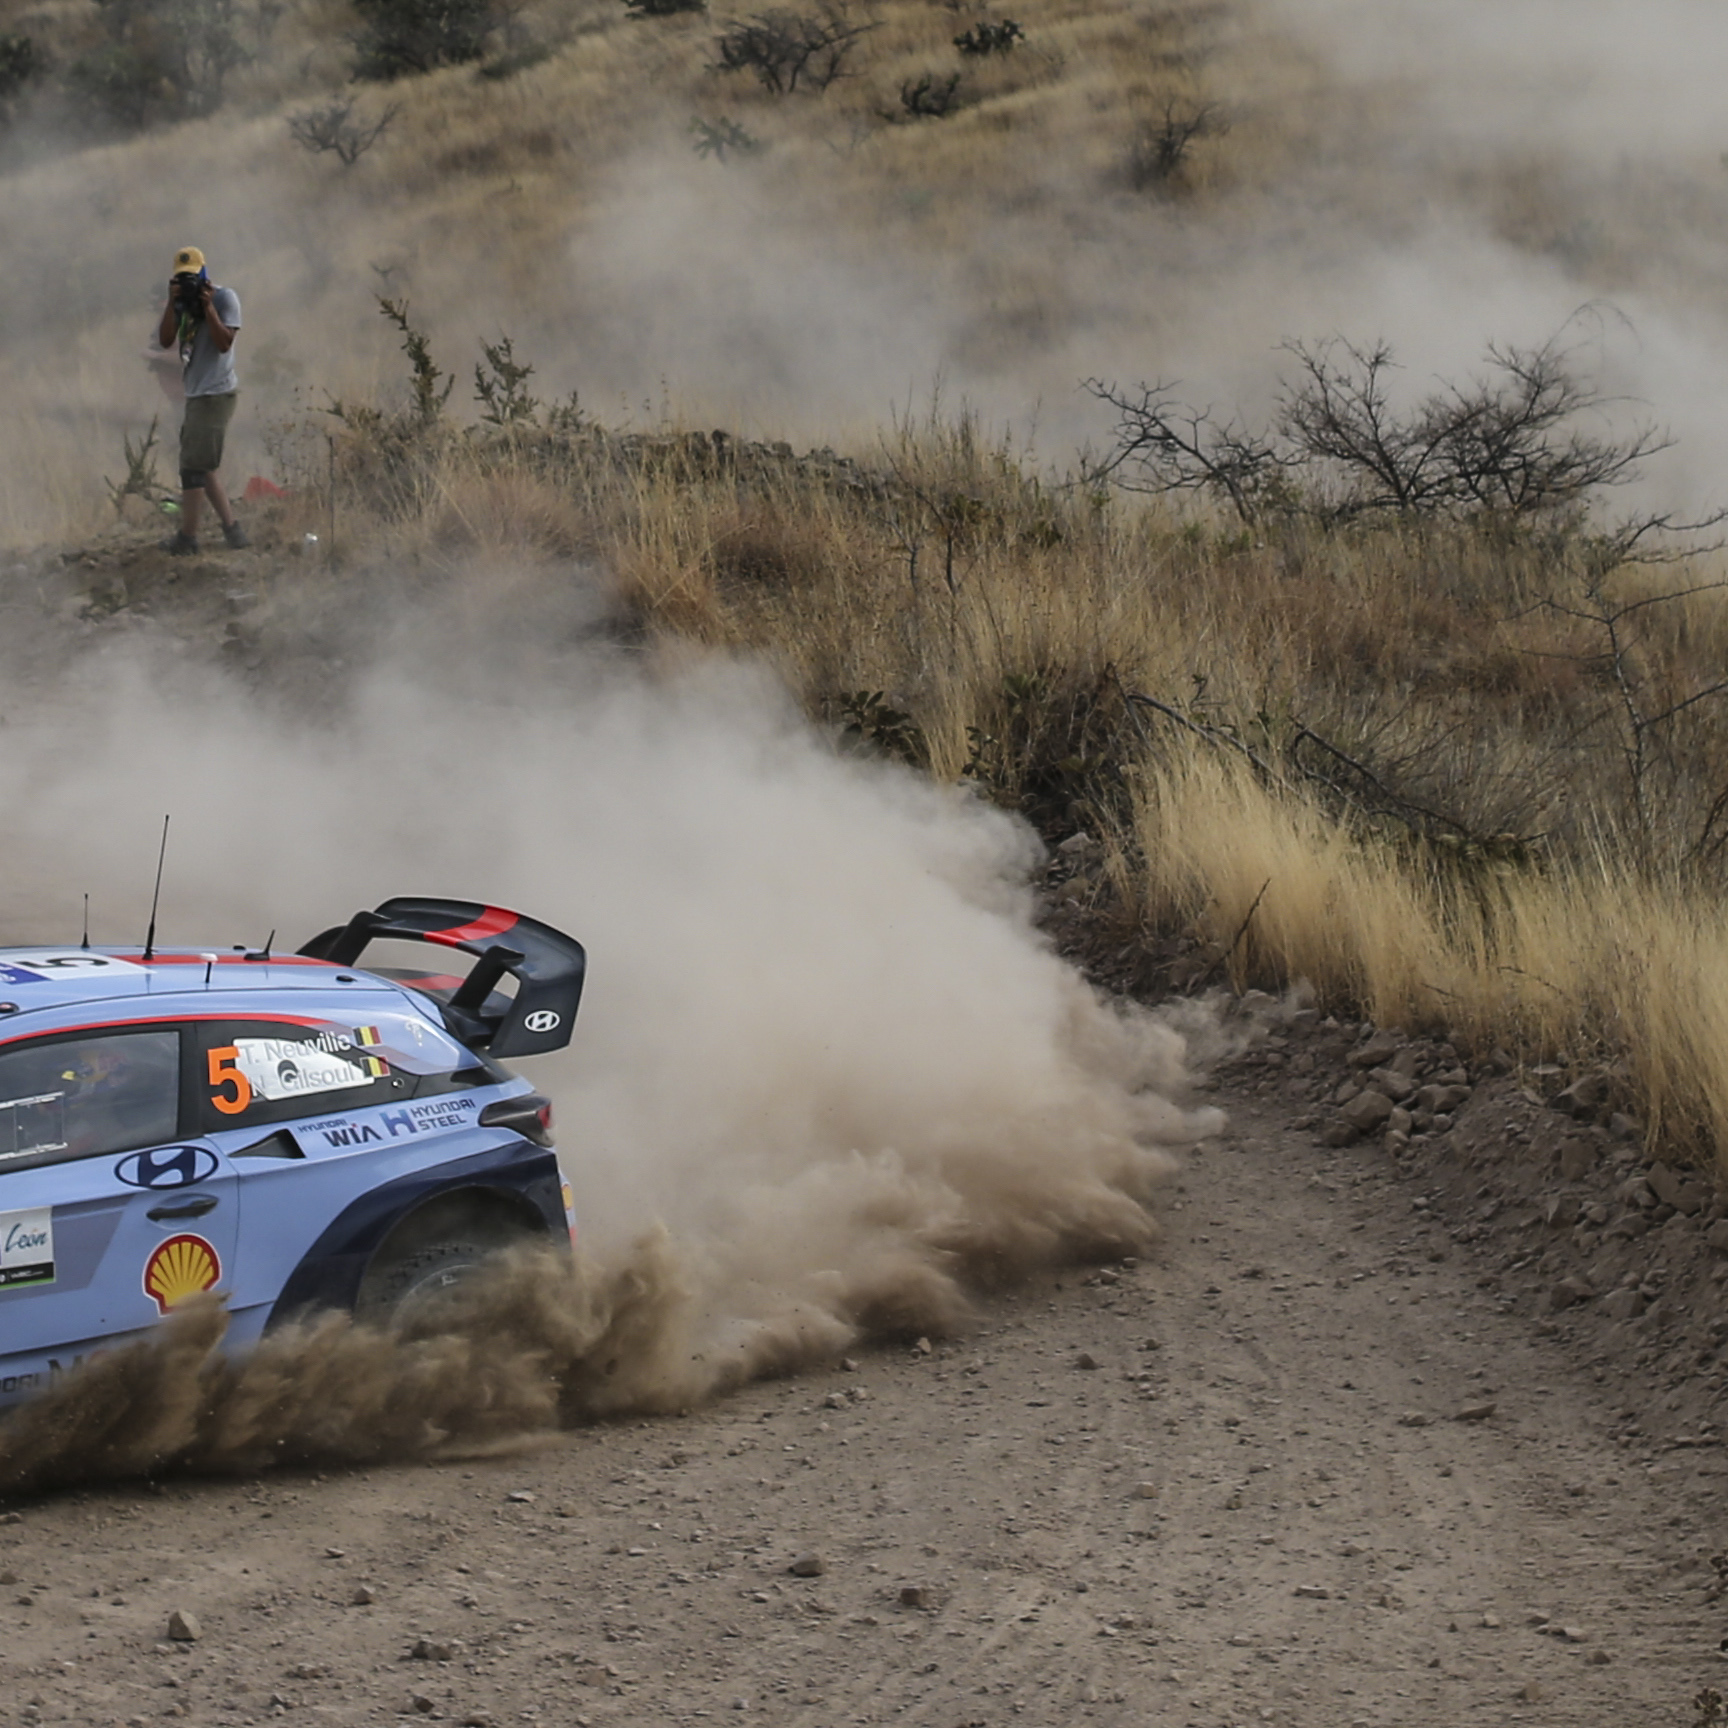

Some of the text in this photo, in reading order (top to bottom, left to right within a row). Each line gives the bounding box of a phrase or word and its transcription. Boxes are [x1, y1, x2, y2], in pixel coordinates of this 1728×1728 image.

[262, 1031, 351, 1061] Neuville
[207, 1046, 252, 1115] 5
[280, 1060, 355, 1092] Gilsoul
[410, 1098, 476, 1119] HYUNDAI
[299, 1118, 348, 1133] HYUNDAI
[417, 1114, 467, 1132] STEEL
